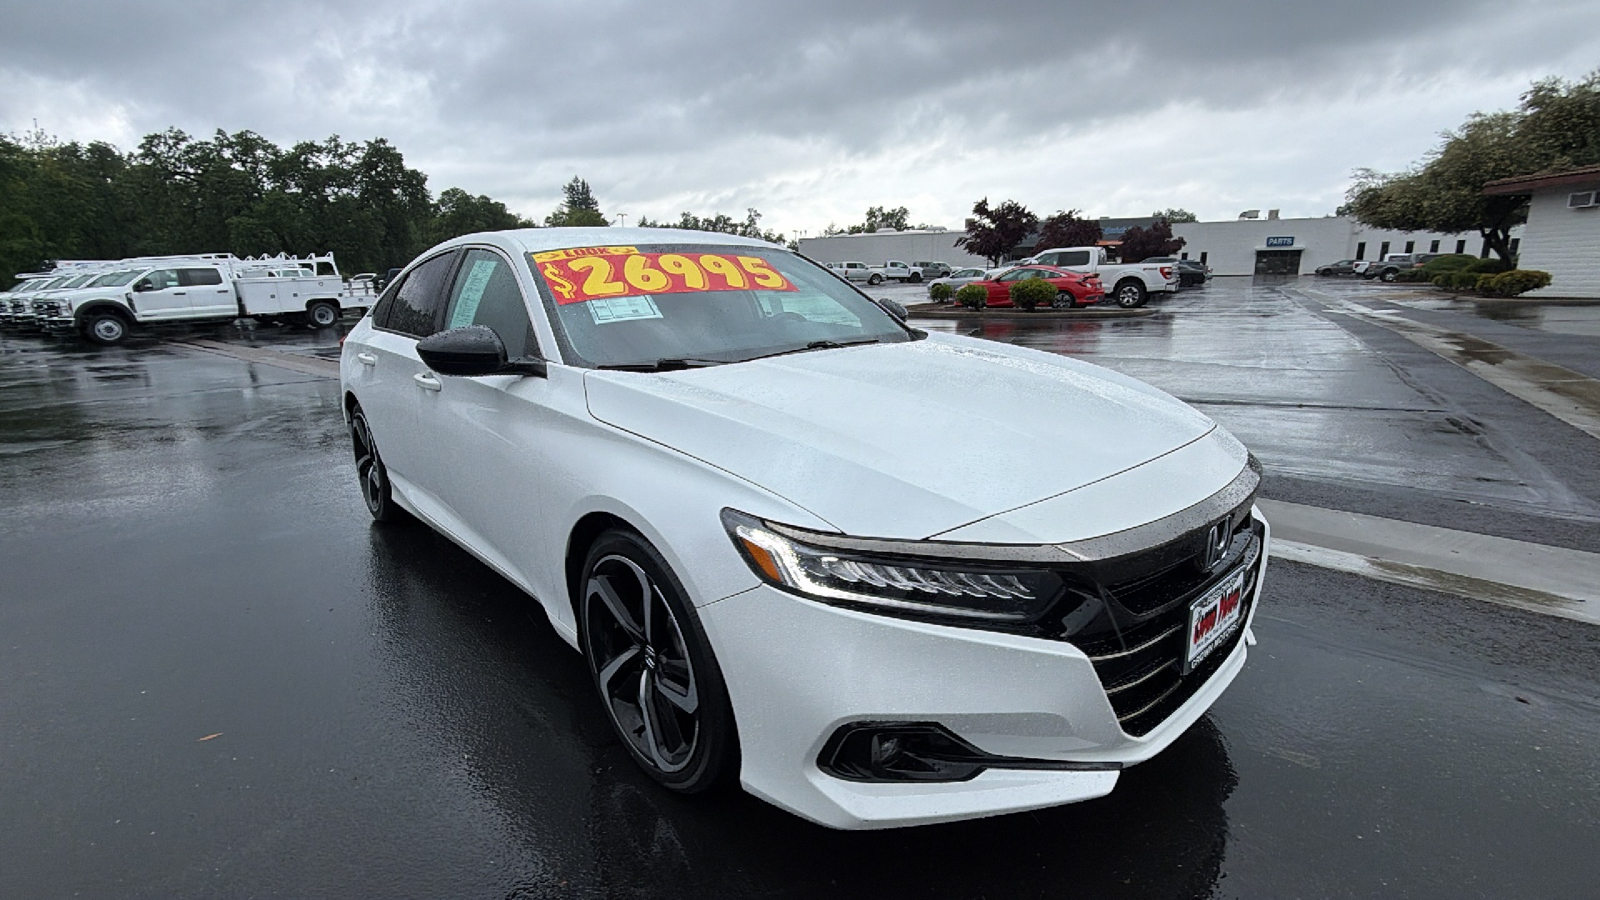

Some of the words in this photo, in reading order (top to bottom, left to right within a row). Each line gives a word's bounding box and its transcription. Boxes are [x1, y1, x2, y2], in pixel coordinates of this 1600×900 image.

[1268, 238, 1293, 246] PARTS
[563, 247, 610, 258] LOOK
[543, 255, 784, 299] $26995
